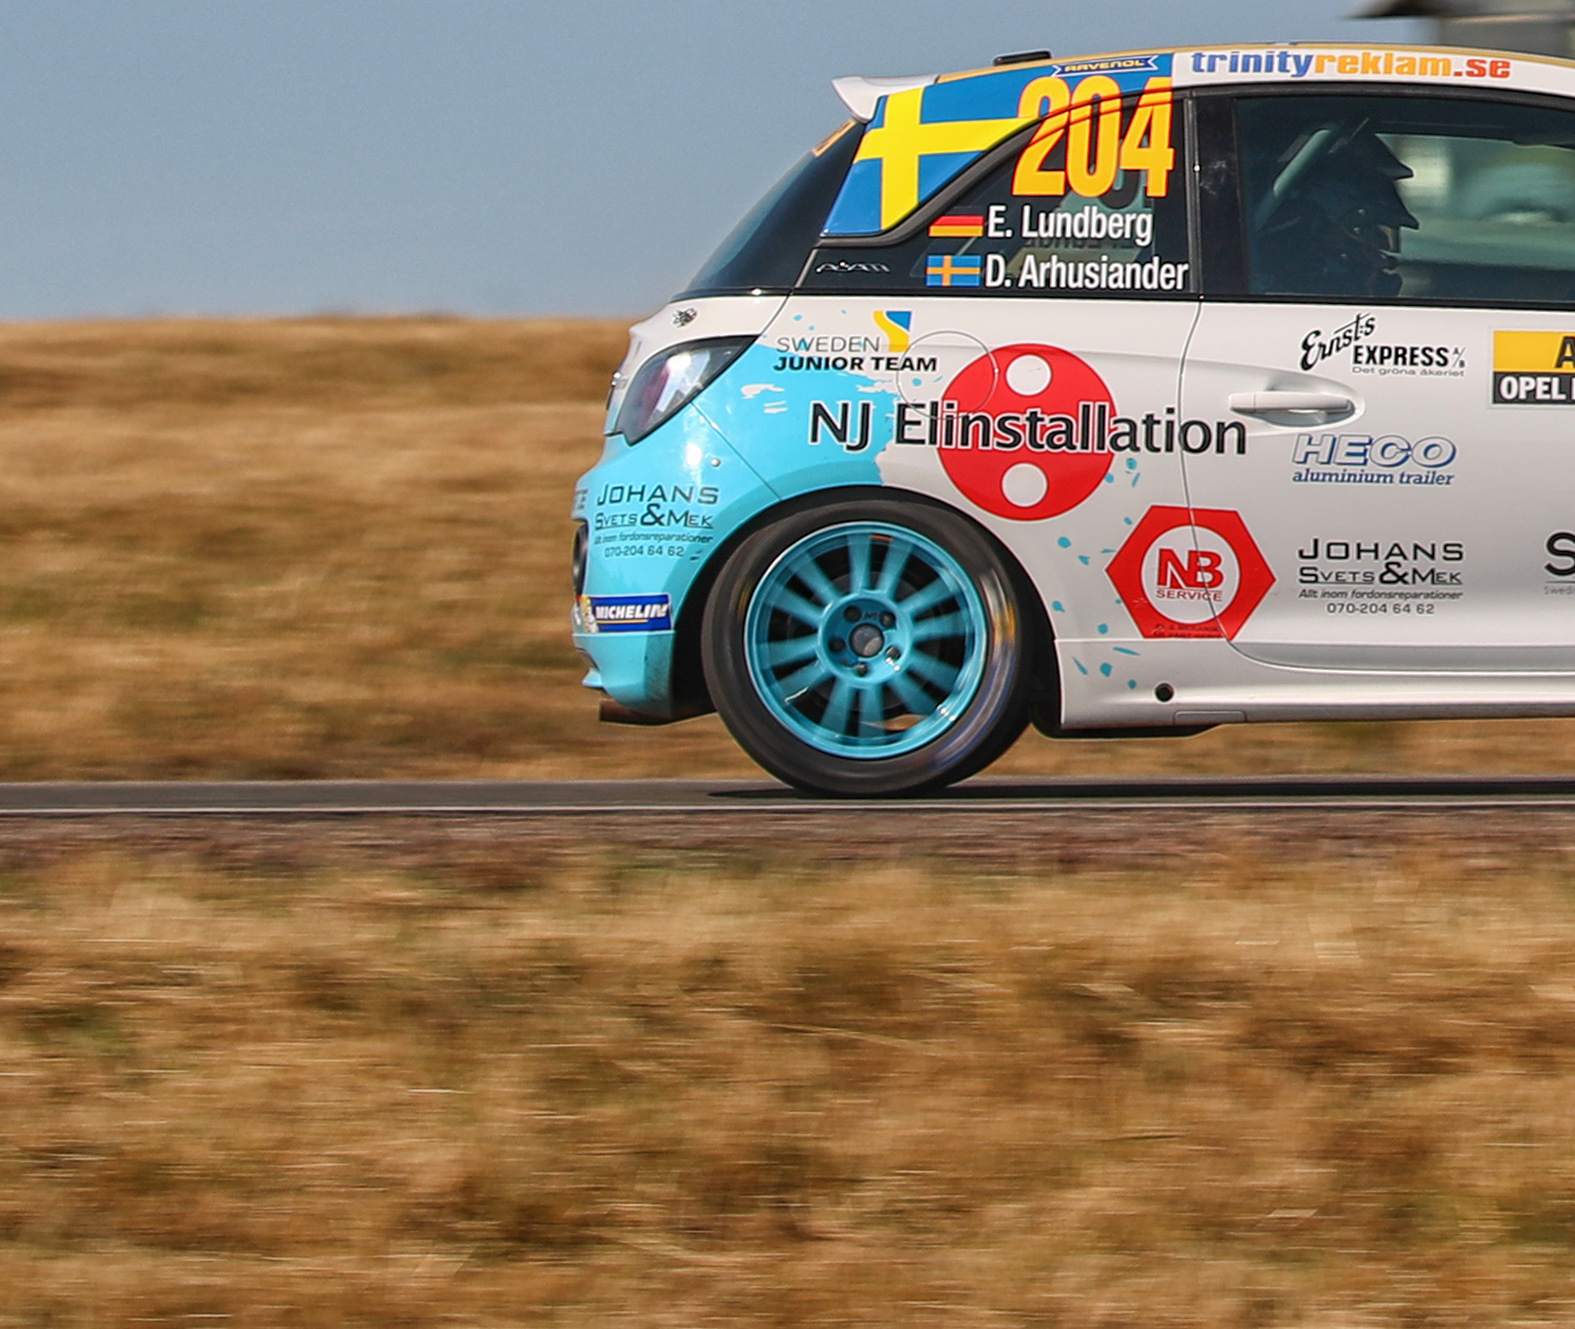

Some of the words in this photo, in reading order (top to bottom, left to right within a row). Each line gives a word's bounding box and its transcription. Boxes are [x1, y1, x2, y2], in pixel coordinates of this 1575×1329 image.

[1064, 59, 1146, 72] RAVENOL
[1191, 50, 1511, 78] trinityreklam.se
[1011, 75, 1175, 197] 204
[987, 205, 1012, 237] E.
[1022, 205, 1153, 246] Lundberg
[985, 254, 1012, 287] D.
[1018, 254, 1189, 290] Arhusiander
[777, 336, 881, 353] SWEDEN
[1353, 345, 1449, 366] EXPRESS
[773, 356, 863, 371] JUNIOR
[870, 357, 937, 371] TEAM
[1500, 375, 1570, 401] OPEL
[810, 402, 871, 451] NJ
[896, 401, 1246, 455] Elinstallation
[1292, 434, 1457, 468] HECO
[1293, 469, 1394, 484] aluminium
[1399, 471, 1455, 485] trailer
[597, 483, 719, 506] JOHANS
[1298, 538, 1464, 561] JOHANS
[1157, 548, 1225, 589] NB
[1156, 589, 1223, 602] SERVICE
[596, 604, 669, 619] MICHELIN
[1327, 603, 1388, 614] 070-204
[1393, 603, 1411, 614] 64
[1416, 603, 1435, 615] 62
